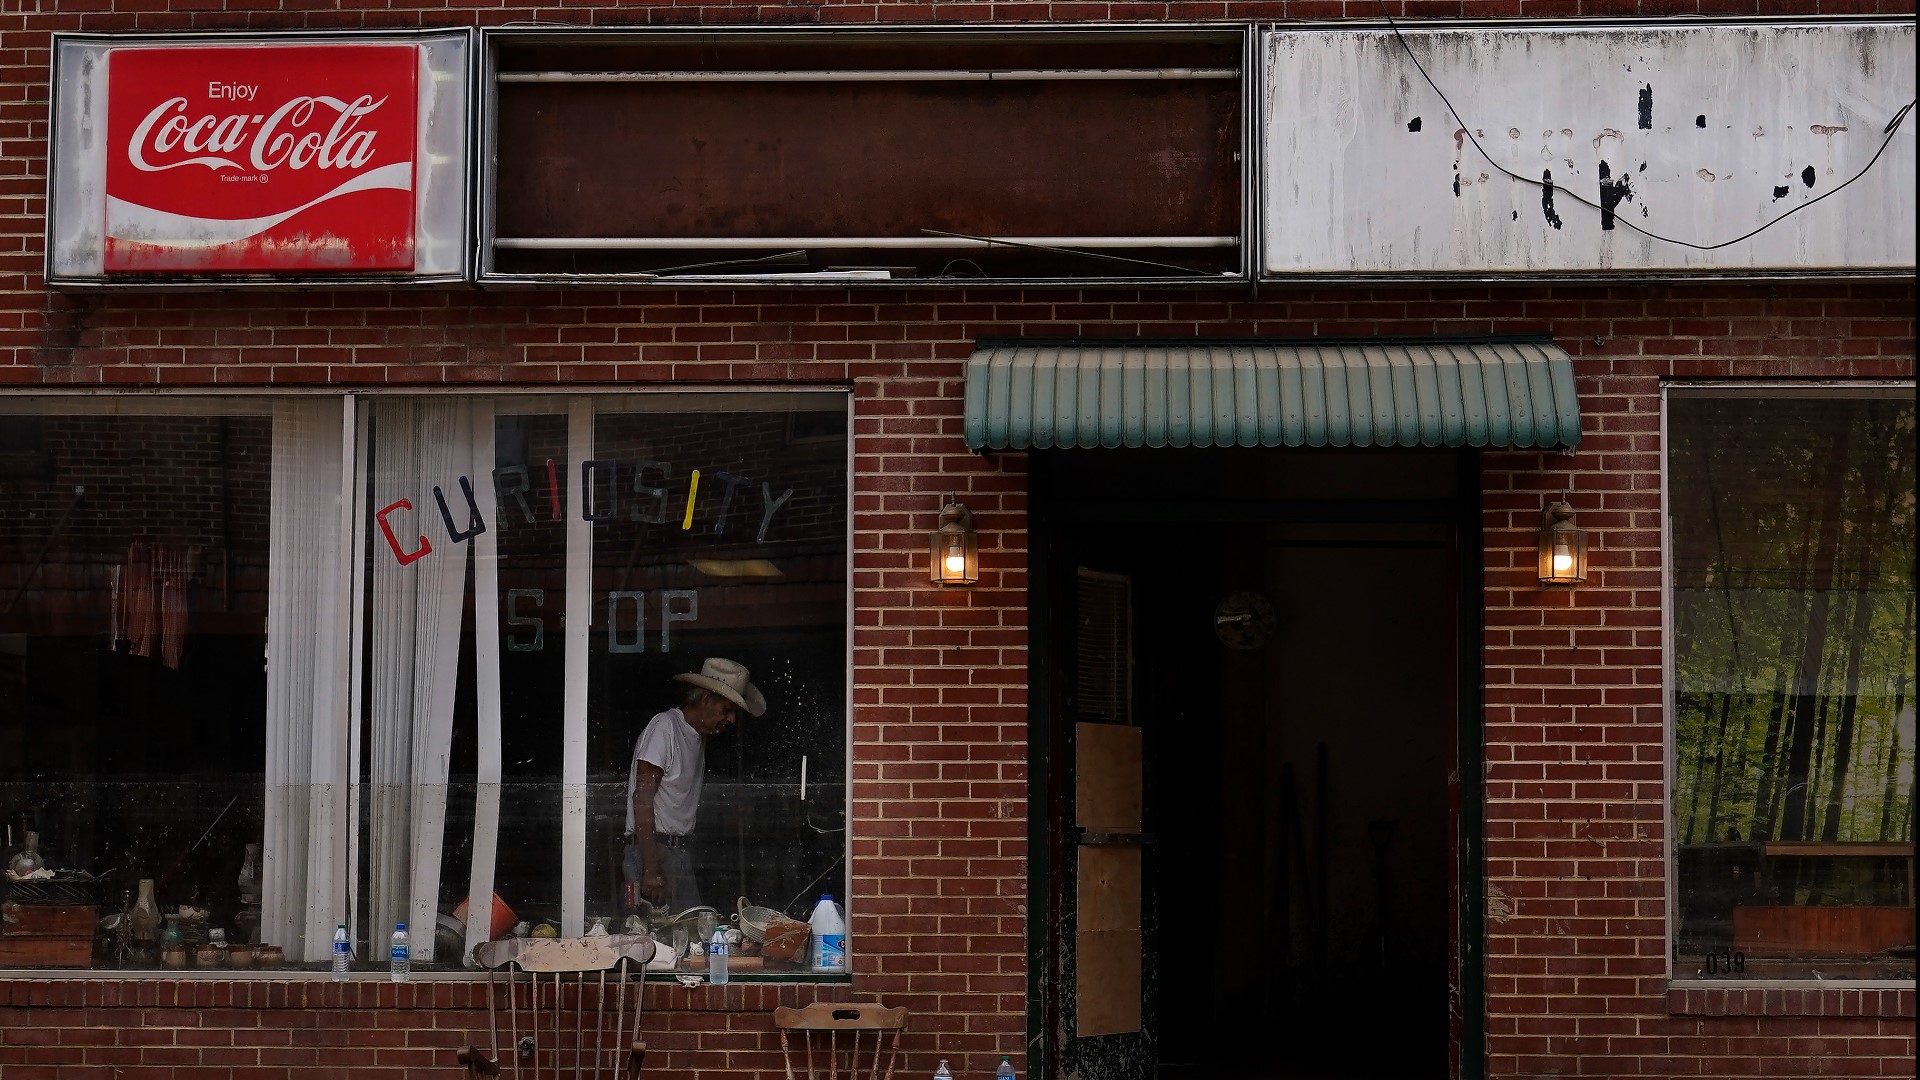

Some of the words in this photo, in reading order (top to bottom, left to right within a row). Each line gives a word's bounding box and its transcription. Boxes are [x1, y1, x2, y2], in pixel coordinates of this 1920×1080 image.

[208, 81, 259, 101] Enjoy
[128, 94, 389, 172] Coca-Cola
[375, 458, 793, 566] CURIOSITY
